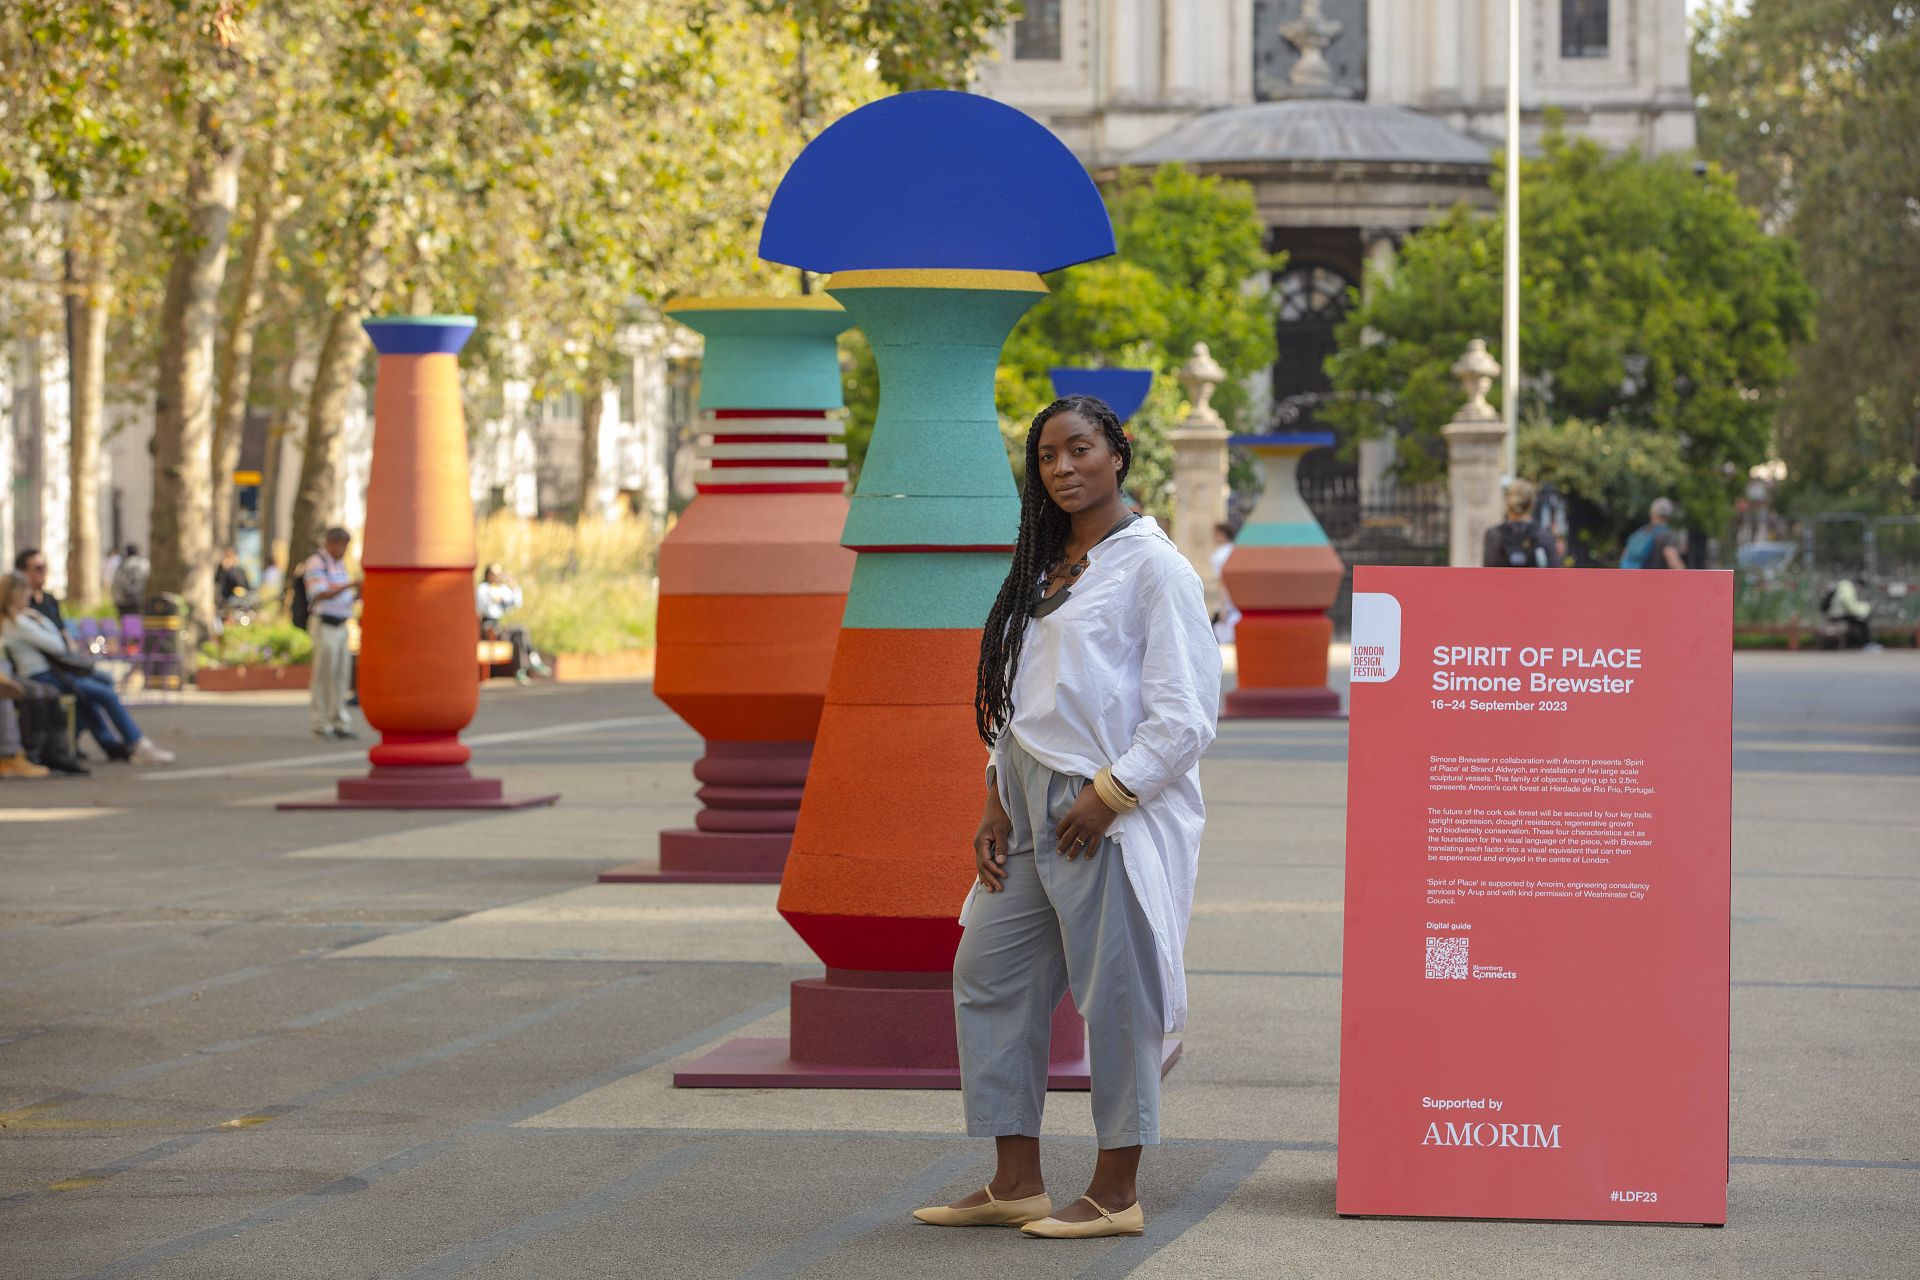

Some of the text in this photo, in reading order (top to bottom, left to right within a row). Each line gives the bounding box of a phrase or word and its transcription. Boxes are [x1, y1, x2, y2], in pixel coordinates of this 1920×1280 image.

[1355, 646, 1384, 656] LONDON
[1354, 657, 1380, 666] DESIGN
[1433, 646, 1641, 668] SPIRIT OF PLACE
[1354, 667, 1386, 676] FESTIVAL
[1432, 671, 1634, 693] Simone Brewster
[1470, 699, 1535, 712] September
[1539, 701, 1567, 711] 2023
[1592, 758, 1622, 767] presents
[1601, 767, 1618, 776] large
[1430, 774, 1463, 783] sculptural
[1511, 775, 1530, 784] family
[1571, 776, 1596, 785] ranging
[1430, 783, 1466, 792] represents
[1620, 810, 1632, 819] key
[1429, 817, 1453, 825] upright
[1496, 818, 1522, 827] drought
[1564, 819, 1607, 828] regenerative
[1609, 820, 1633, 828] growth
[1444, 826, 1482, 835] biodiversity
[1525, 837, 1557, 846] language
[1428, 844, 1463, 853] translating
[1549, 846, 1583, 856] equivalent
[1439, 853, 1482, 863] experienced
[1499, 854, 1525, 864] enjoyed
[1488, 879, 1524, 888] supported
[1567, 880, 1607, 890] engineering
[1609, 881, 1650, 891] consultancy
[1467, 888, 1484, 897] Arup
[1535, 889, 1572, 898] permission
[1630, 891, 1644, 900] City
[1426, 922, 1471, 931] Digital guide
[1473, 971, 1516, 979] Connects
[1422, 1097, 1502, 1111] Supported by
[1421, 1122, 1561, 1148] AMORIM
[1610, 1191, 1657, 1202] #LDF23
